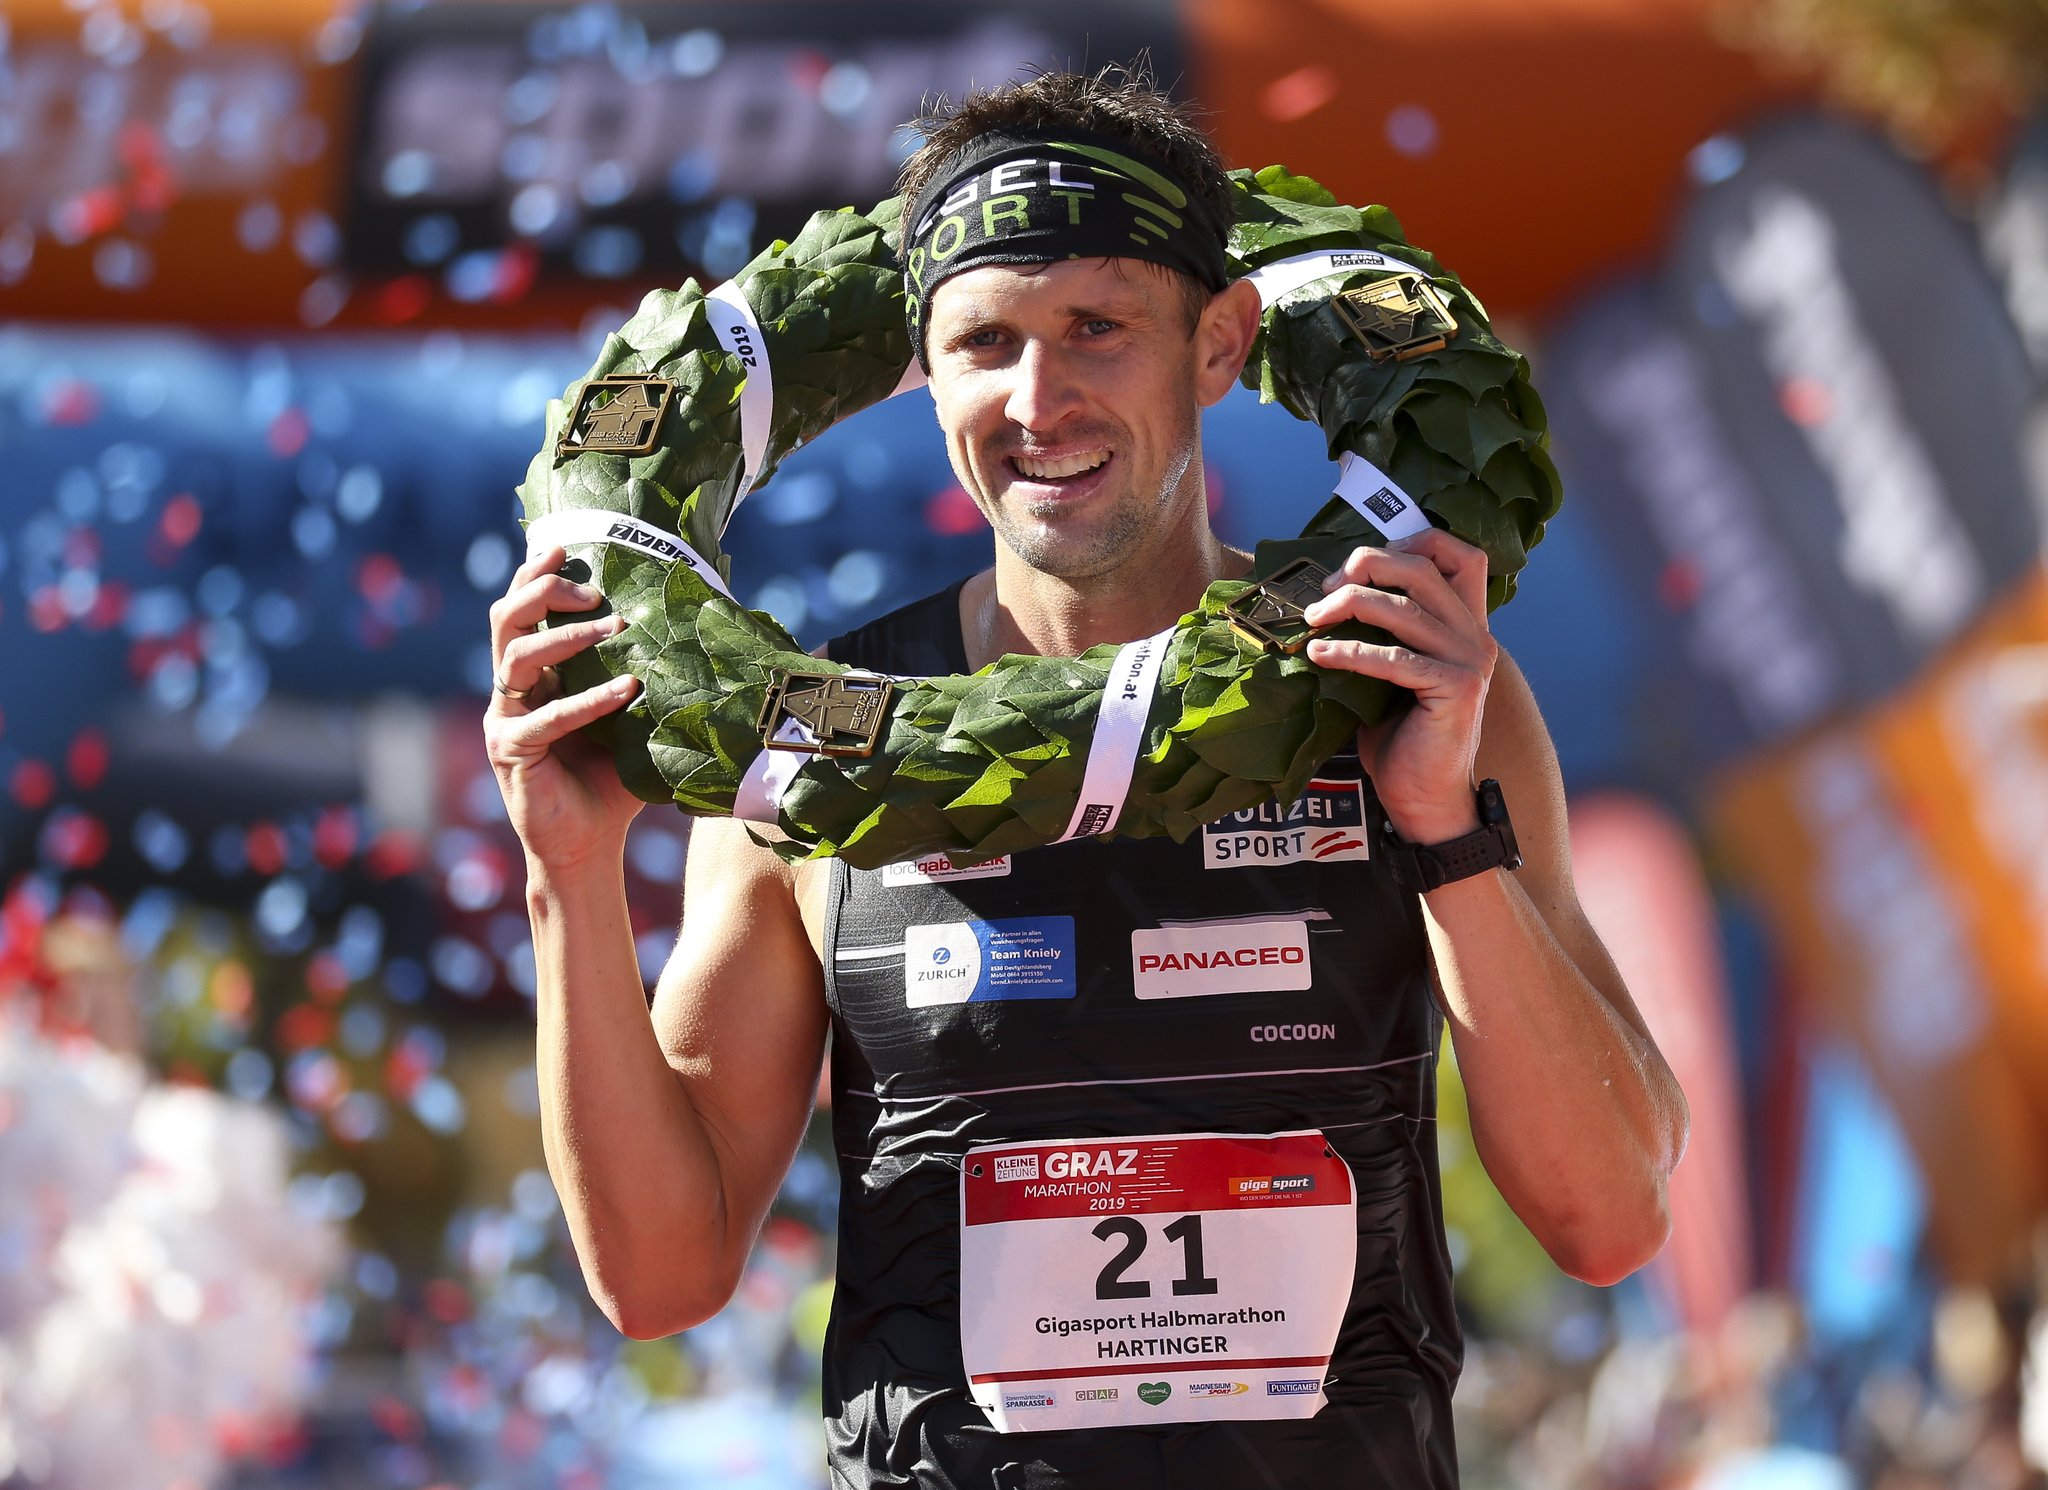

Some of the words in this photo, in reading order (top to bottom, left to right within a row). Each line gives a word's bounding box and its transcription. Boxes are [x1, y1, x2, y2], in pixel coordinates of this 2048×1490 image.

[730, 325, 758, 368] 2019
[1376, 490, 1403, 513] KLEINE
[1215, 832, 1305, 860] SPORT
[1002, 930, 1021, 938] Partner
[990, 950, 1021, 960] Team
[1023, 947, 1061, 960] Kniely
[1139, 946, 1304, 973] PANACEO
[918, 968, 966, 982] ZURICH
[1250, 1023, 1336, 1042] COCOON
[996, 1157, 1036, 1169] KLEINE
[1044, 1149, 1139, 1179] GRAZ
[996, 1167, 1037, 1180] ZEITUNG
[1024, 1181, 1111, 1198] MARATHON
[1239, 1179, 1269, 1192] giga
[1272, 1177, 1310, 1190] sport
[1089, 1197, 1126, 1211] 2019
[1090, 1213, 1219, 1301] 21
[1035, 1311, 1137, 1337] Gigasport
[1141, 1306, 1286, 1330] Halbmarathon
[1097, 1335, 1229, 1359] HARTINGER
[1189, 1382, 1231, 1391] MAGNESIUM
[1271, 1382, 1318, 1393] PUNTIGAMER
[1005, 1394, 1046, 1402] Steiermärkische
[1076, 1389, 1118, 1401] GRAZ
[1005, 1399, 1046, 1408] SPARKASSE
